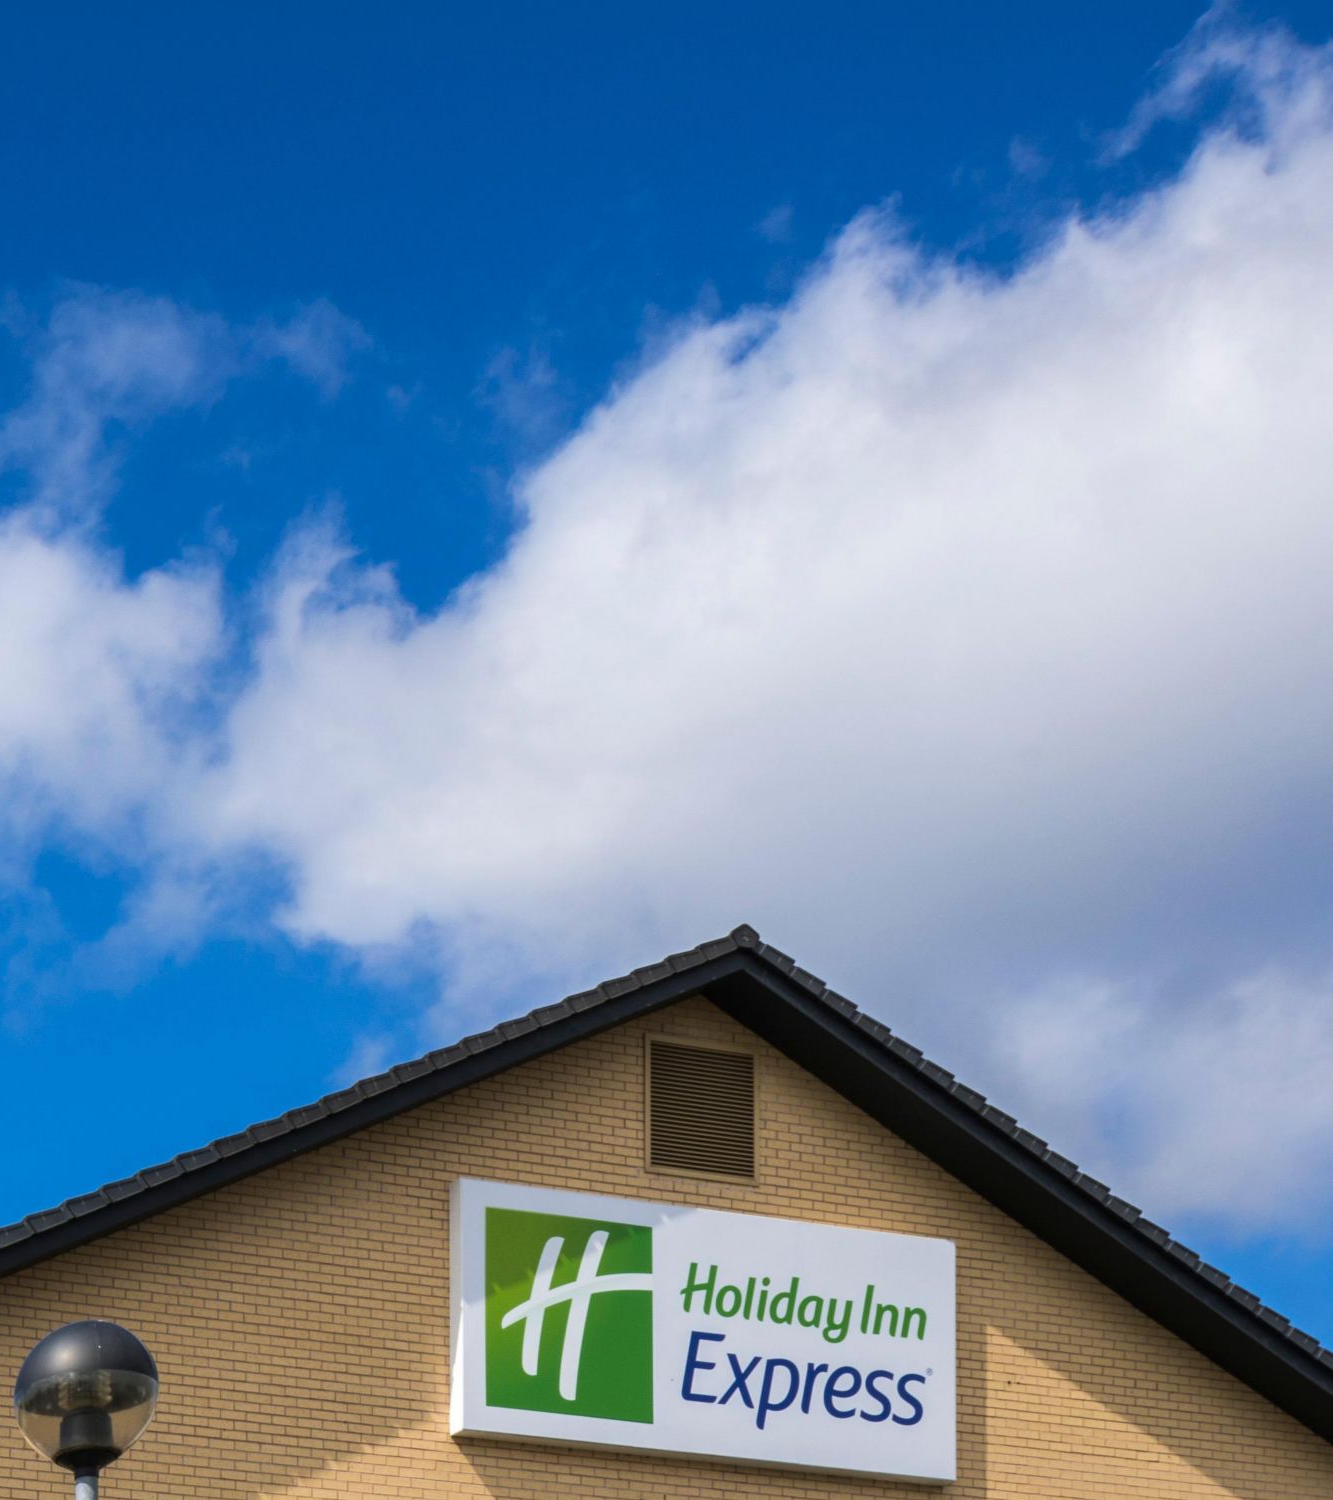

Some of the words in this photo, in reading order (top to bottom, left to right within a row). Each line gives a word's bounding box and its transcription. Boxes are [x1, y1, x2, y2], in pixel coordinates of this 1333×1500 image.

[680, 1262, 853, 1344] Holiday
[860, 1284, 927, 1341] Inn
[681, 1330, 926, 1430] Express
